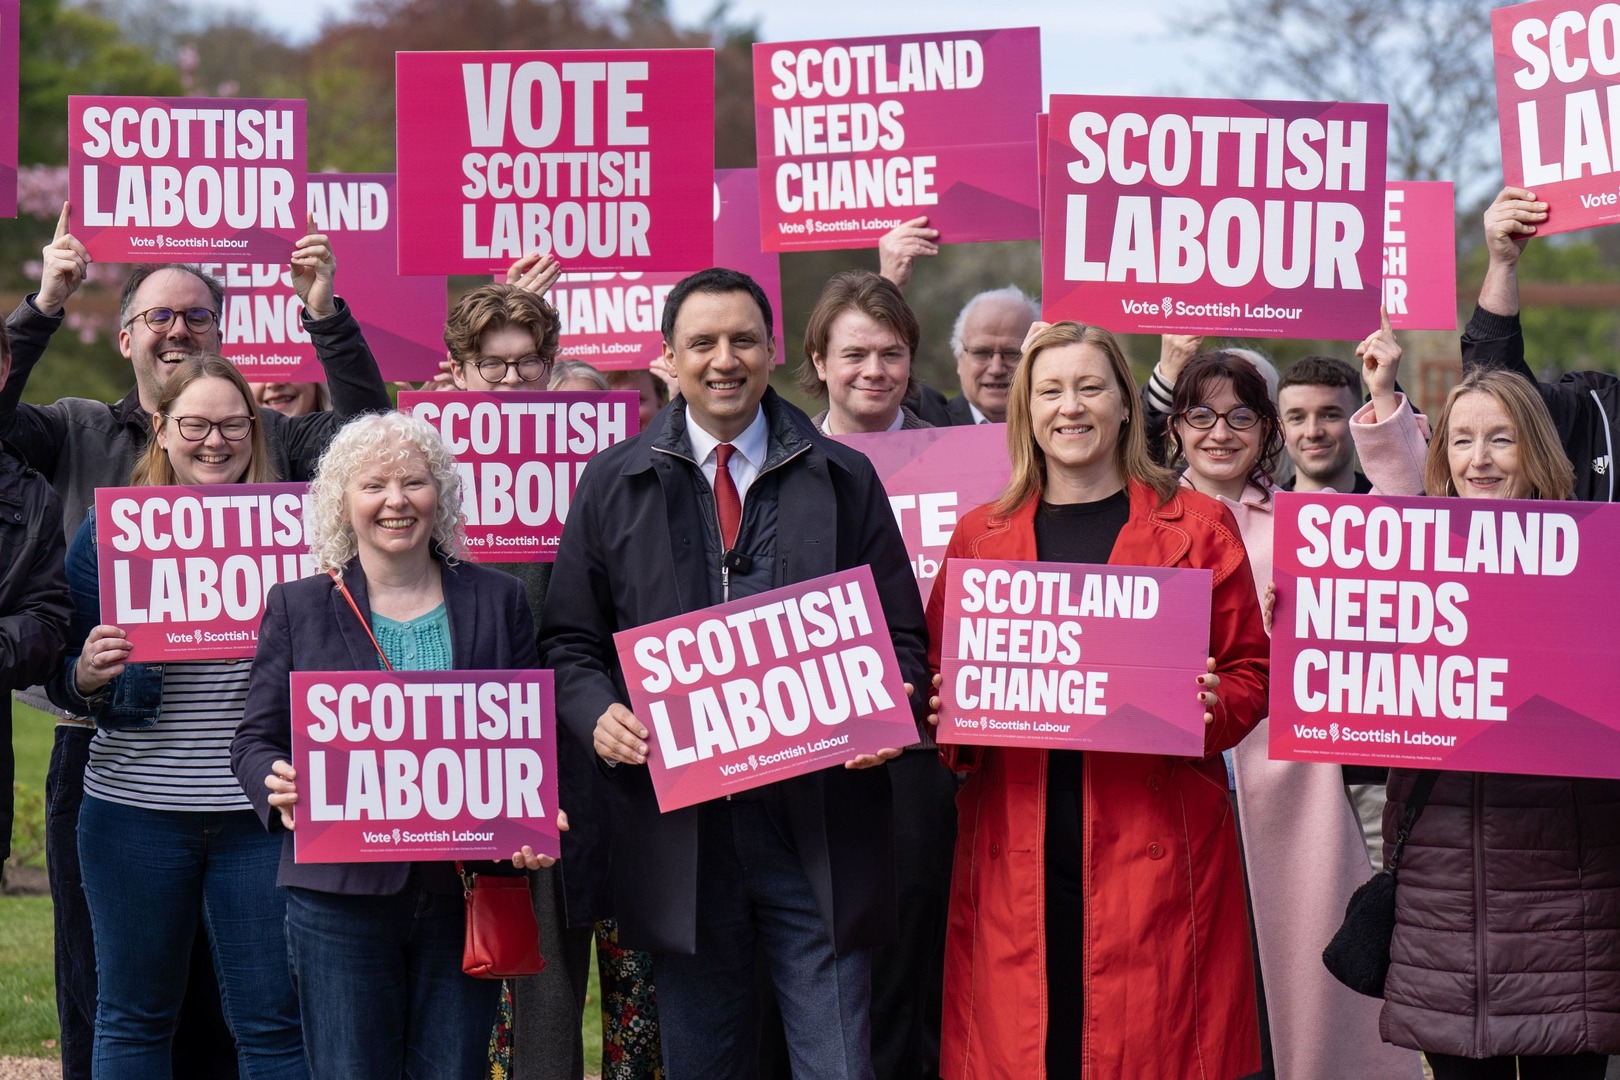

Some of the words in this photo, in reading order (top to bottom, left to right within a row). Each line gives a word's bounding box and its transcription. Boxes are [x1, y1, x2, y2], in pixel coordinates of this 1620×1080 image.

[771, 39, 984, 101] SCOTLAND
[462, 61, 649, 148] VOTE
[773, 100, 905, 156] NEEDS
[82, 106, 294, 160] SCOTTISH
[1067, 111, 1368, 192] SCOTTISH
[83, 165, 295, 229] LABOUR
[462, 151, 650, 199] SCOTTISH
[775, 156, 938, 213] CHANGE
[1580, 192, 1617, 209] Vote
[130, 236, 155, 248] Vote
[165, 236, 208, 249] Scottish
[210, 237, 249, 249] Labour
[462, 201, 651, 259] LABOUR
[779, 222, 805, 234] Vote
[815, 219, 859, 232] Scottish
[1064, 194, 1365, 290] LABOUR
[1121, 299, 1160, 315] Vote
[1175, 300, 1241, 318] Scottish
[1244, 303, 1303, 320] Labour
[260, 353, 302, 365] Labour
[560, 344, 600, 355] cottish
[602, 343, 642, 354] Labour
[495, 535, 539, 546] Scottish
[1296, 504, 1580, 577] SCOTLAND
[960, 568, 1160, 620] SCOTLAND
[1295, 577, 1470, 647] NEEDS
[166, 632, 193, 643] Vote
[203, 630, 249, 642] Scottish
[633, 580, 873, 694] SCOTTISH
[957, 617, 1083, 666] NEEDS
[649, 645, 896, 770] LABOUR
[955, 665, 1109, 716] CHANGE
[1293, 648, 1509, 722] CHANGE
[306, 682, 542, 742] SCOTTISH
[954, 717, 979, 729] Vote
[988, 719, 1031, 731] Scottish
[1032, 721, 1071, 733] Labour
[1293, 724, 1328, 740] Vote
[1341, 726, 1401, 745] Scottish
[1404, 731, 1457, 747] Labour
[720, 763, 748, 777] Vote
[758, 745, 807, 767] Scottish
[807, 734, 849, 753] Labour
[308, 747, 546, 822] LABOUR
[362, 831, 391, 844] Vote
[402, 830, 450, 843] Scottish
[452, 830, 495, 842] Labour
